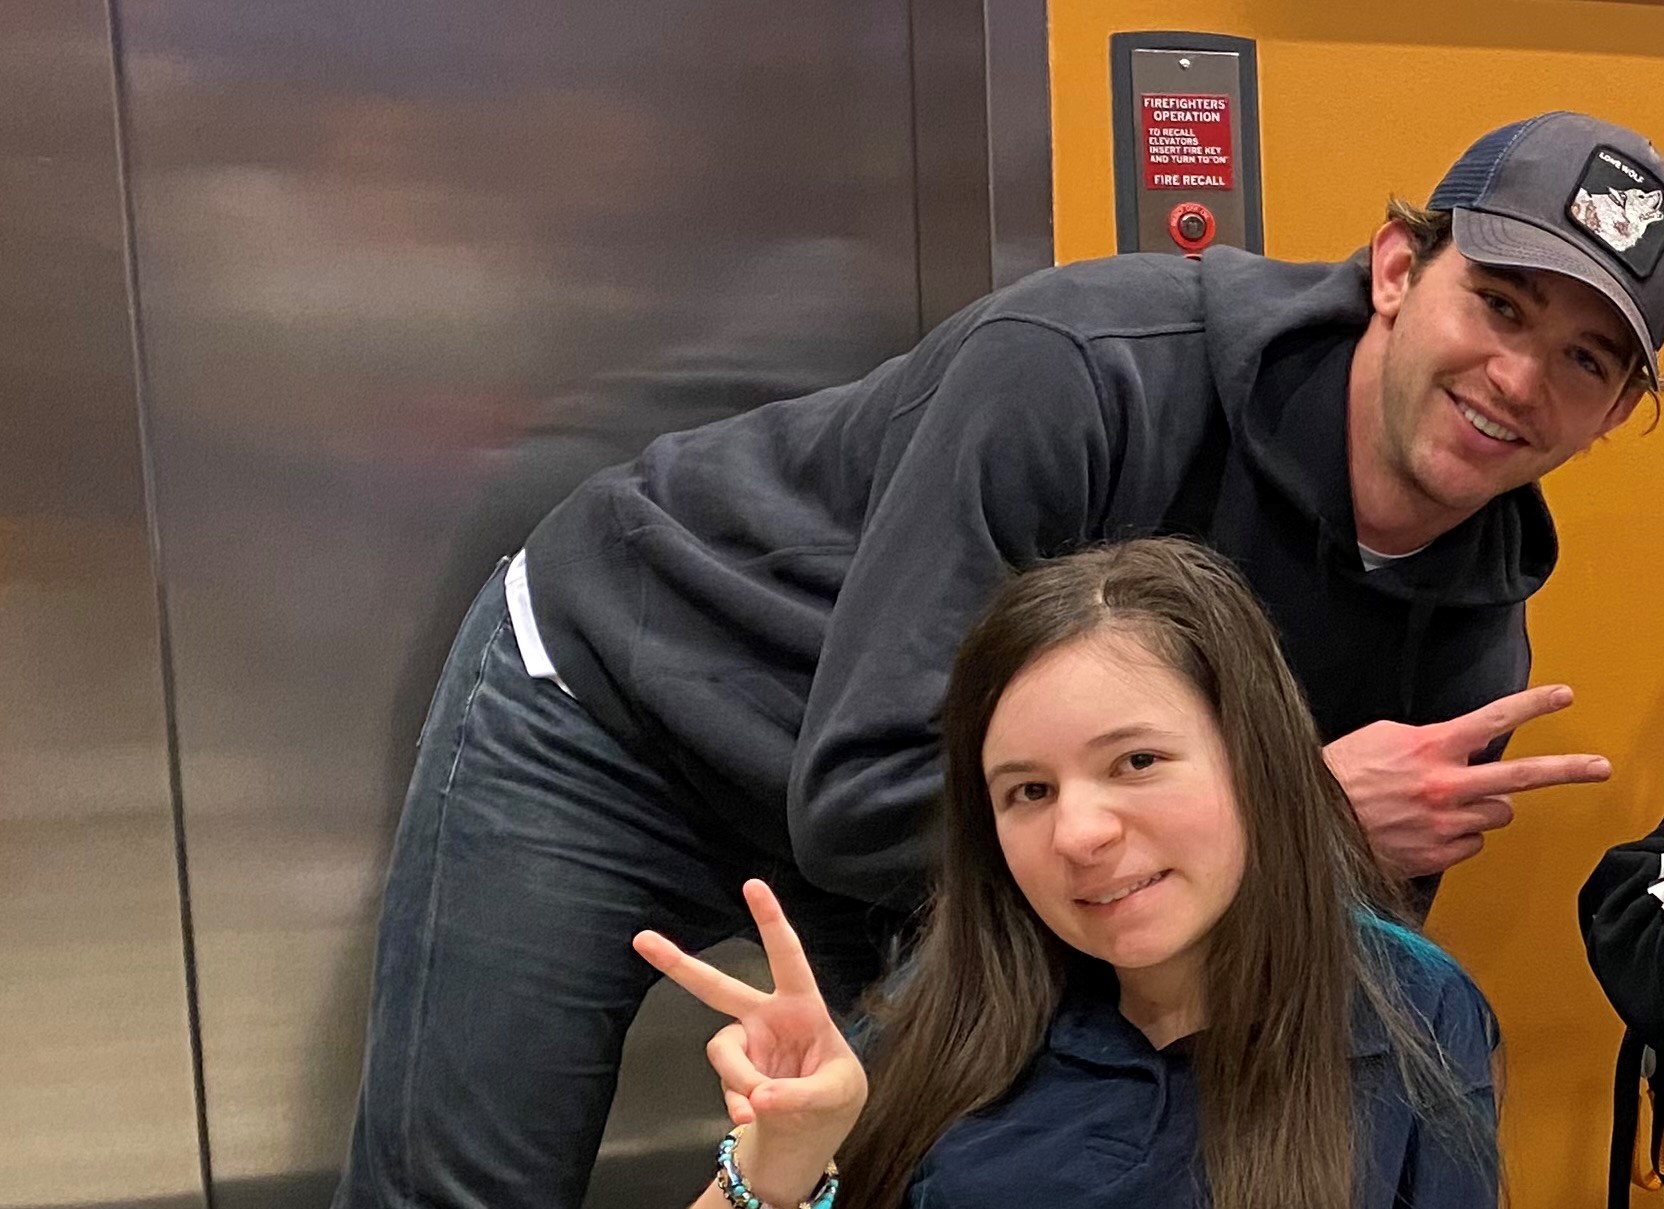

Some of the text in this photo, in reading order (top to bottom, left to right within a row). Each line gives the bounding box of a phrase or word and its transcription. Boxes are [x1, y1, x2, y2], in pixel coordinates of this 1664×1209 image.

[1153, 110, 1221, 122] OPERATION
[1148, 128, 1195, 136] TO RECALL
[1149, 137, 1199, 145] ELEVATORS
[1149, 146, 1221, 155] INSERT FIRE KEY
[1150, 155, 1169, 163] AND
[1170, 155, 1195, 163] TURN
[1621, 165, 1645, 183] WOLF
[1154, 174, 1226, 186] FIRE RECALL
